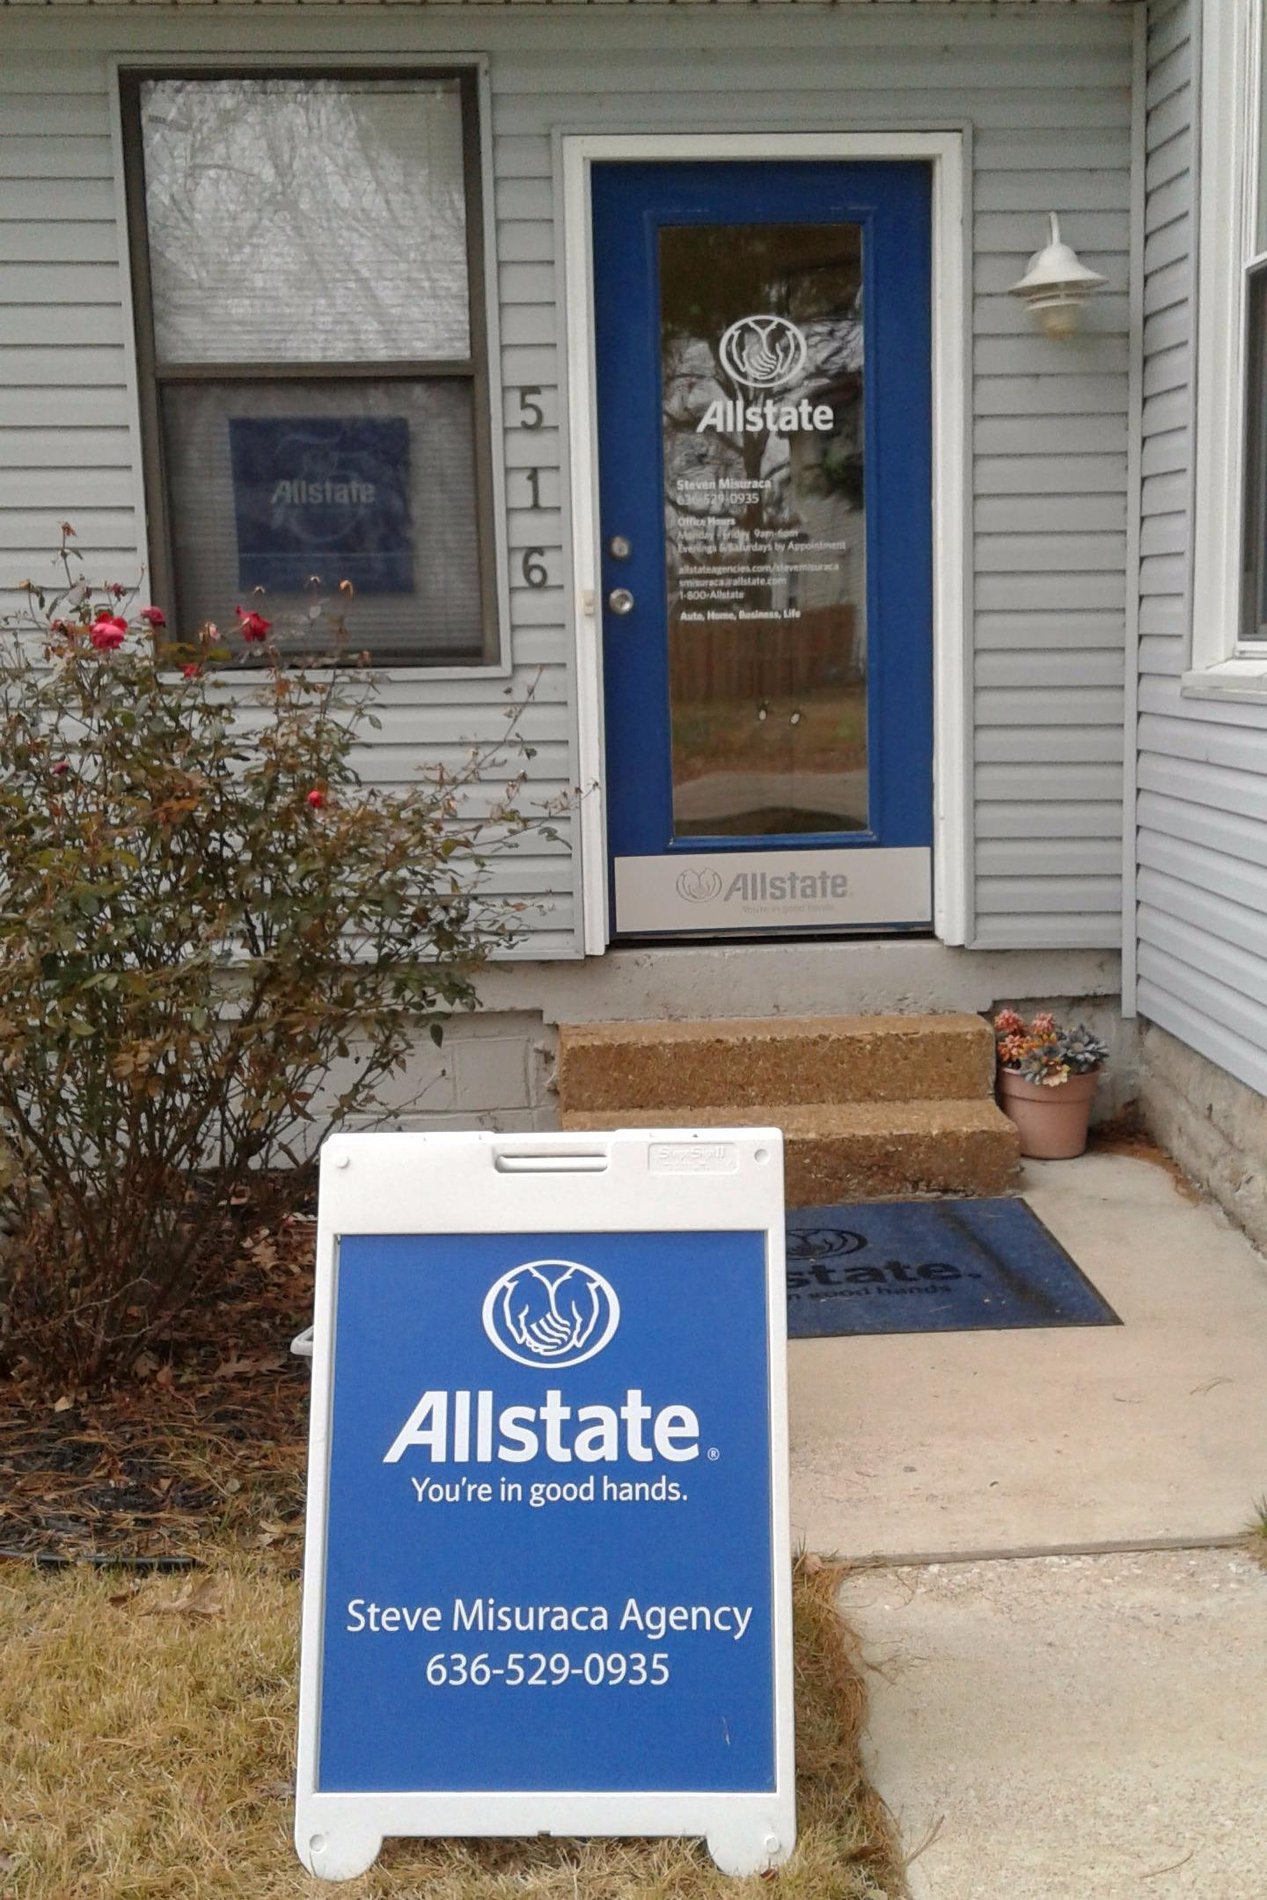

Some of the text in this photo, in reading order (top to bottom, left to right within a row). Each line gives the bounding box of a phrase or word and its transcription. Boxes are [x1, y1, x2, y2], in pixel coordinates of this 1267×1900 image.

[696, 399, 834, 432] Allstate
[271, 479, 376, 504] Allstate
[676, 478, 772, 491] Steven Misuraca
[677, 516, 736, 527] Office Hours
[678, 542, 717, 554] Evenings
[727, 541, 772, 553] Saturdays
[774, 541, 785, 552] by
[788, 540, 846, 552] Appointment
[680, 590, 744, 600] 1-800-Allstate
[680, 609, 801, 621] Auto, Home, Business, Life
[723, 871, 847, 901] Allstate
[787, 1260, 962, 1289] state
[383, 1389, 699, 1463] Allstate
[411, 1475, 688, 1508] You're in good hands.
[346, 1599, 753, 1640] Steve Misuraca Agency
[426, 1653, 670, 1686] 636-529-0935
